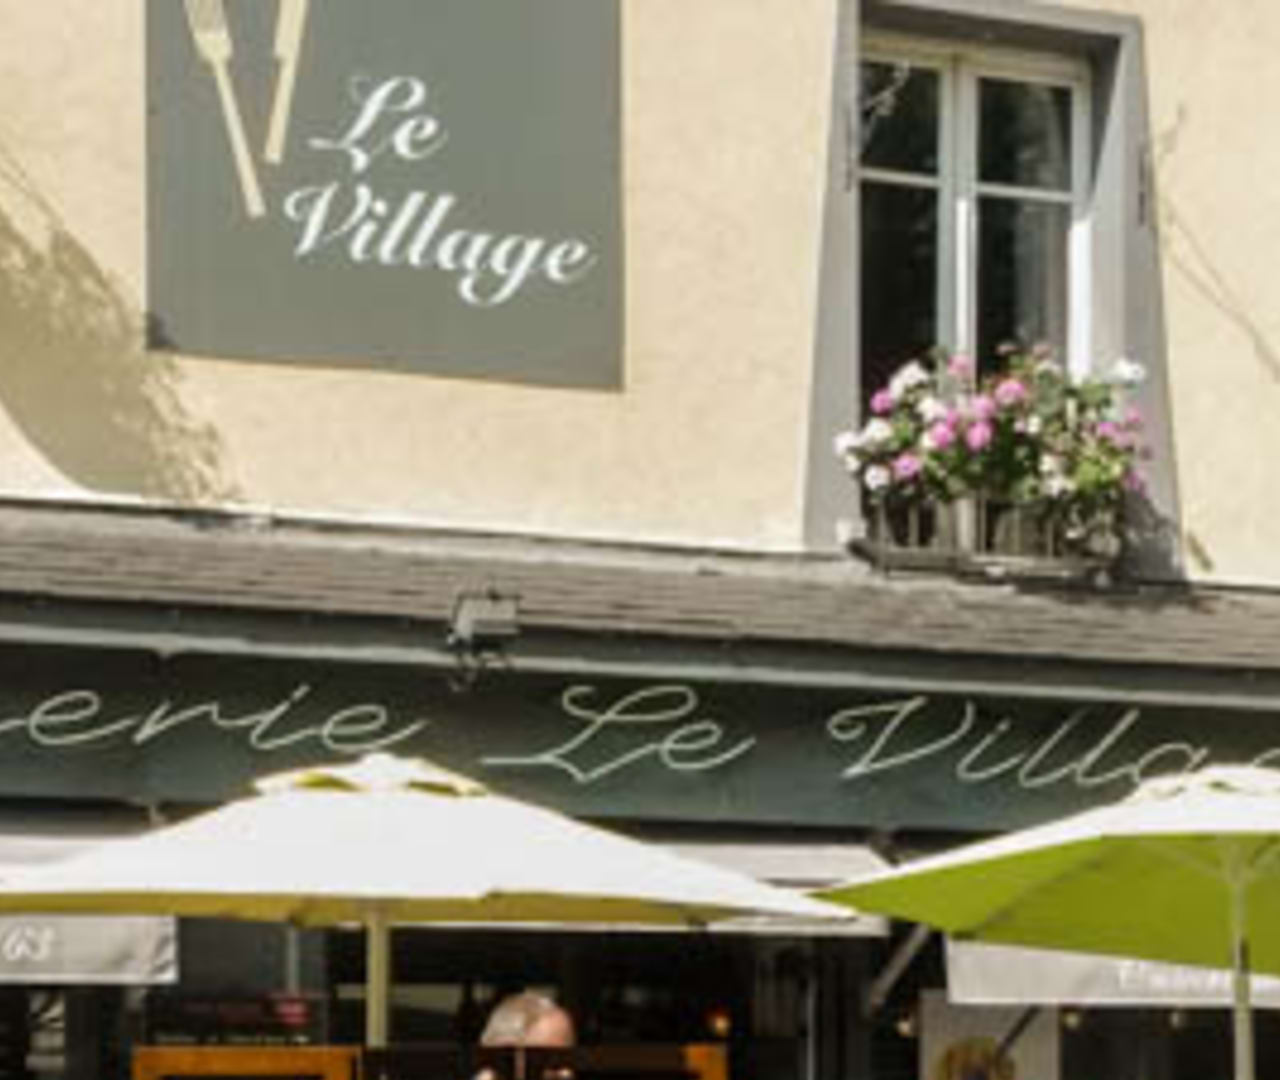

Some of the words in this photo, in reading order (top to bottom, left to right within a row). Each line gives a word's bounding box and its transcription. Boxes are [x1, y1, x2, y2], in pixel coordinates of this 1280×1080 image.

[308, 75, 448, 172] Le
[283, 180, 598, 307] Village
[480, 685, 757, 783] Le
